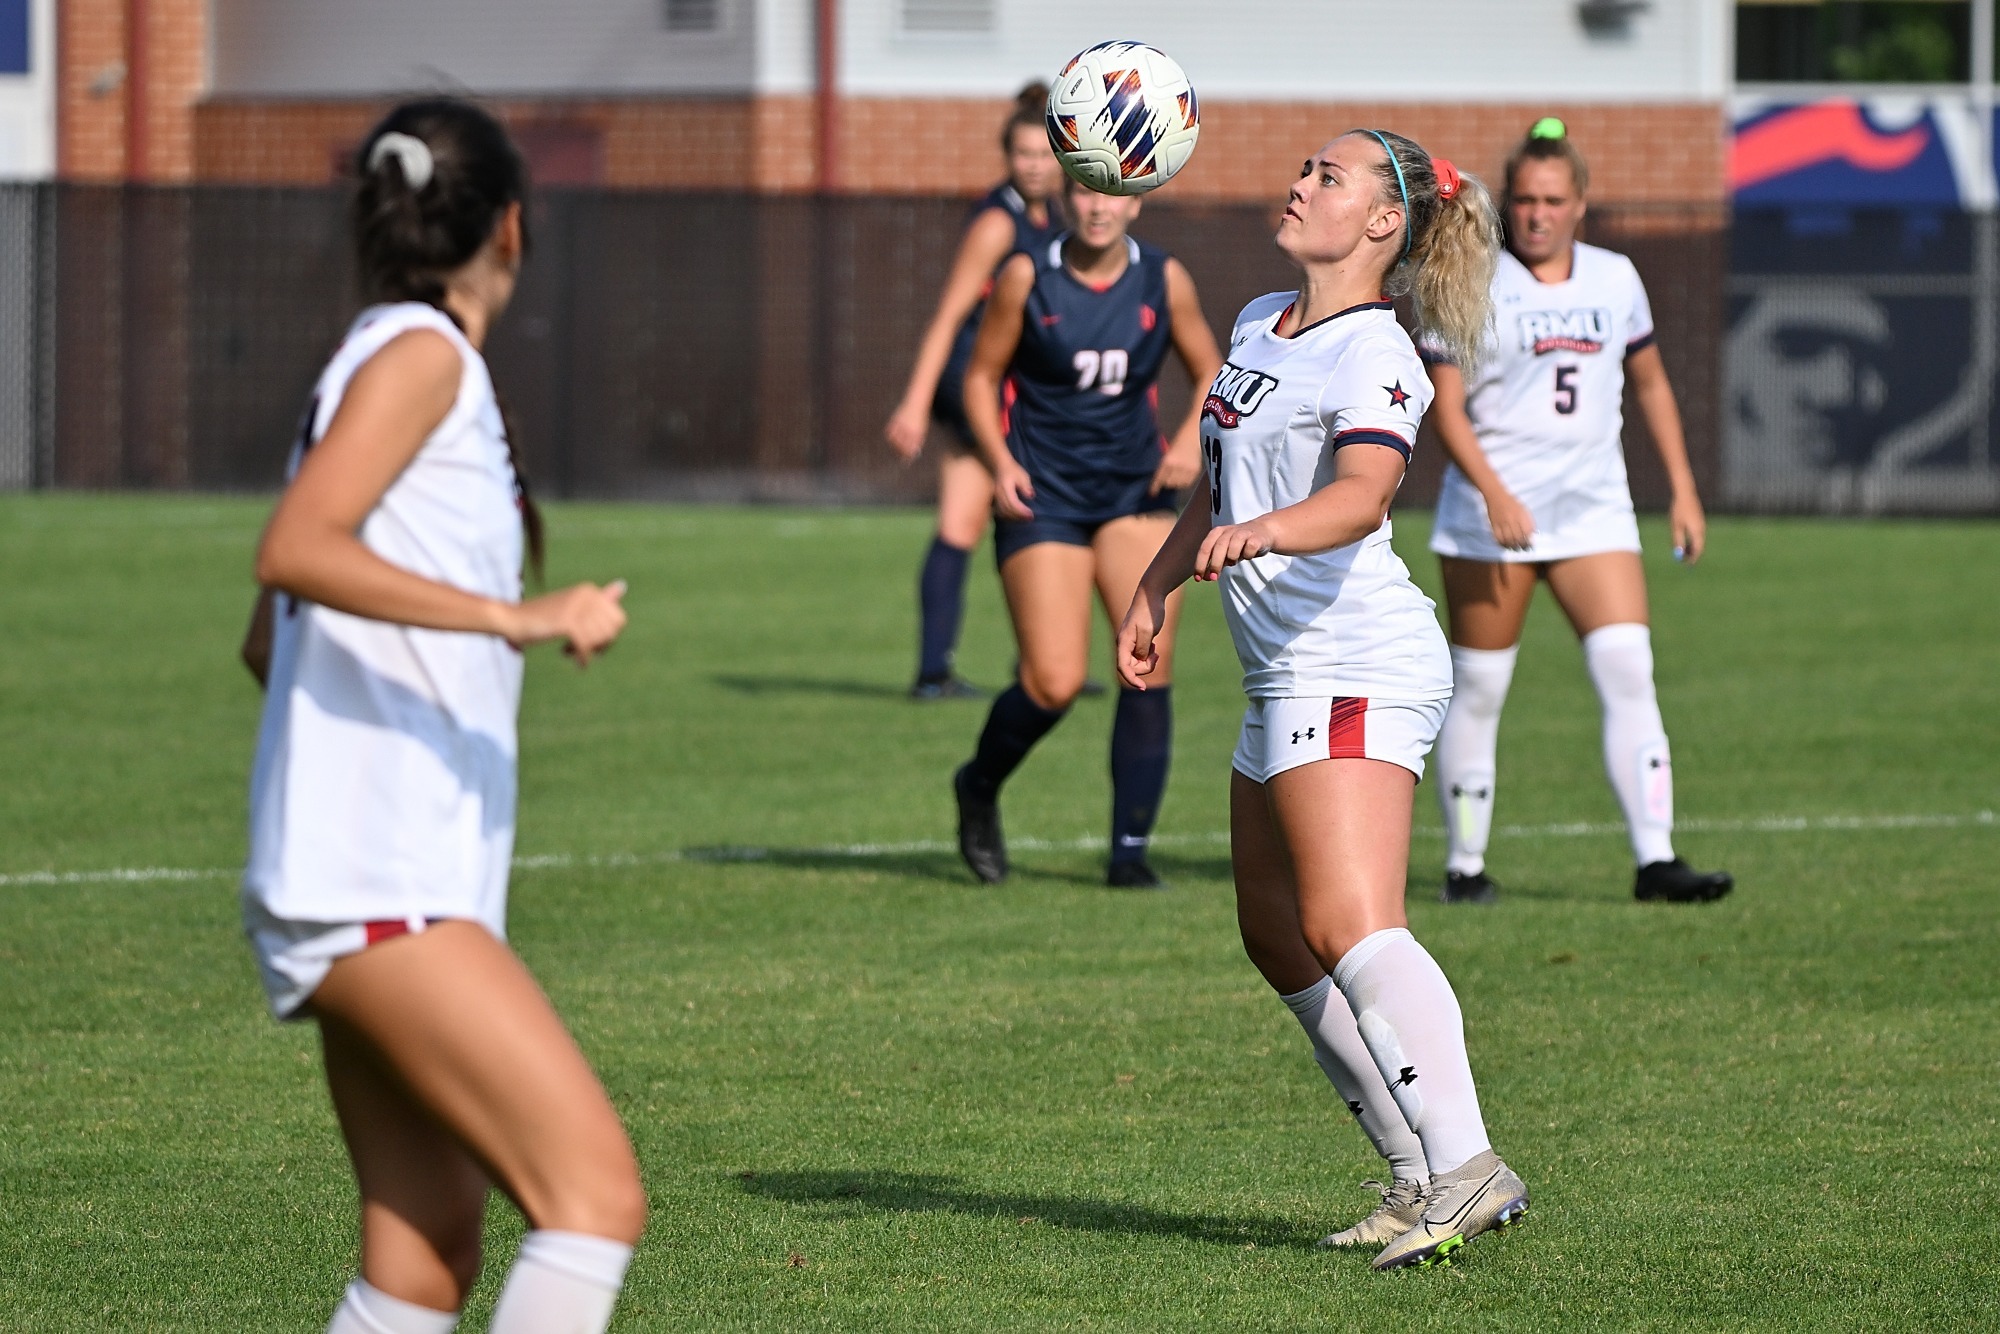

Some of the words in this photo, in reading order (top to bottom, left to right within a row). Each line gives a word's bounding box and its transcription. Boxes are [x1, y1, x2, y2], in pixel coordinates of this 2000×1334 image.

[1517, 309, 1612, 351] RMU
[1204, 399, 1234, 424] COLONIALS
[1208, 362, 1278, 415] RMU
[1555, 365, 1578, 415] 5
